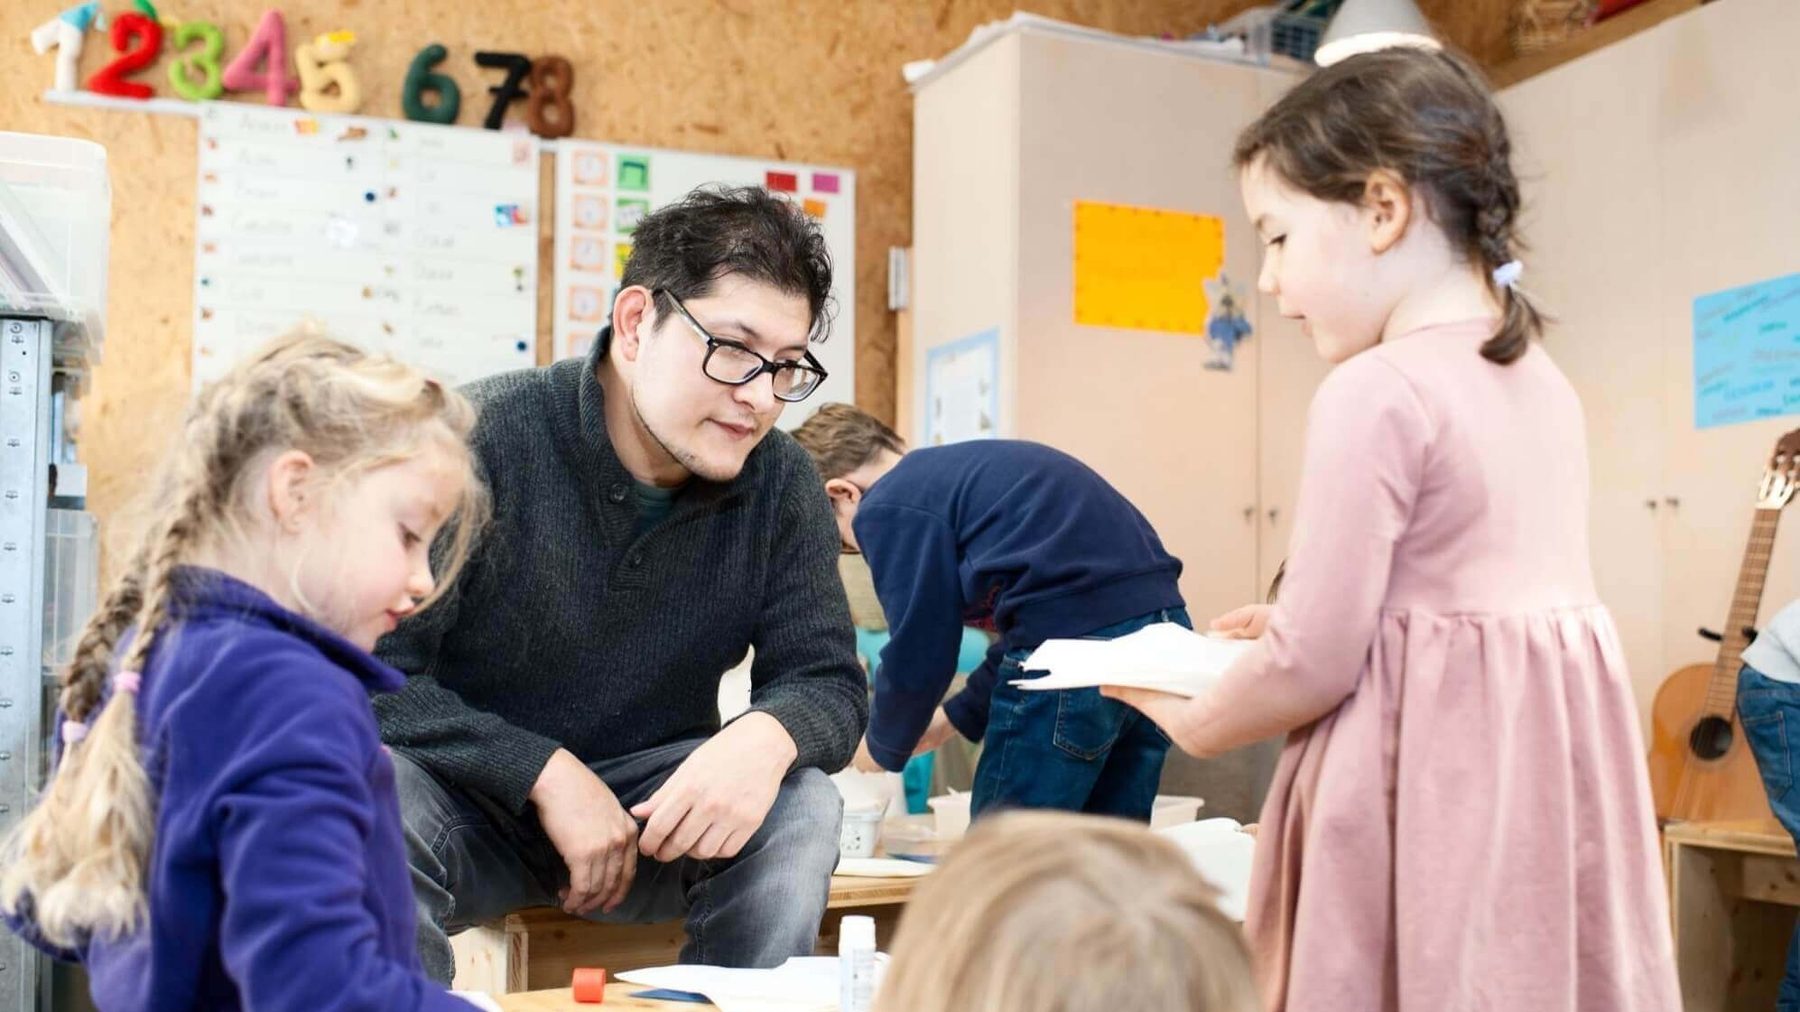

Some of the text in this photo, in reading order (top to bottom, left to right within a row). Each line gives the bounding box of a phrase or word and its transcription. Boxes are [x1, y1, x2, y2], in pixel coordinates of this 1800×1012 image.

[30, 2, 575, 138] 1 2 3 4 5 6 7 8
